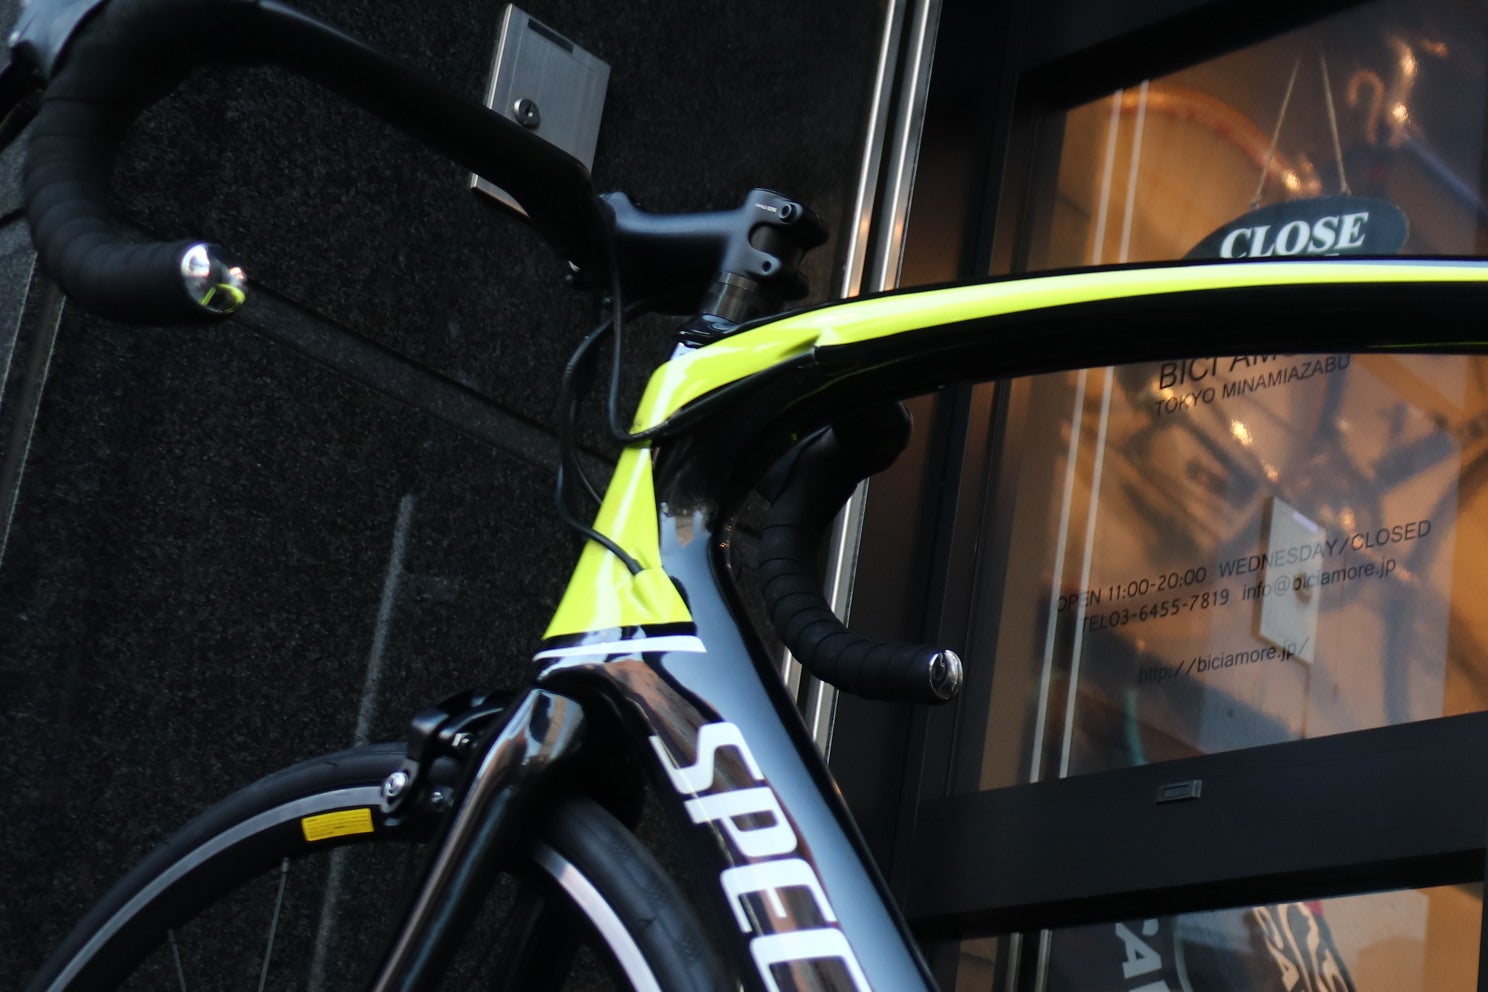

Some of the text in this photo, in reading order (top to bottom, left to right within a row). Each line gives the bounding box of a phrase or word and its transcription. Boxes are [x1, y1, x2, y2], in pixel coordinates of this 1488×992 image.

[1220, 211, 1369, 258] CLOSE
[1155, 387, 1216, 417] TOKYO
[1222, 354, 1351, 399] MINAMIAZABU
[1108, 566, 1207, 601] 11:00-20:00
